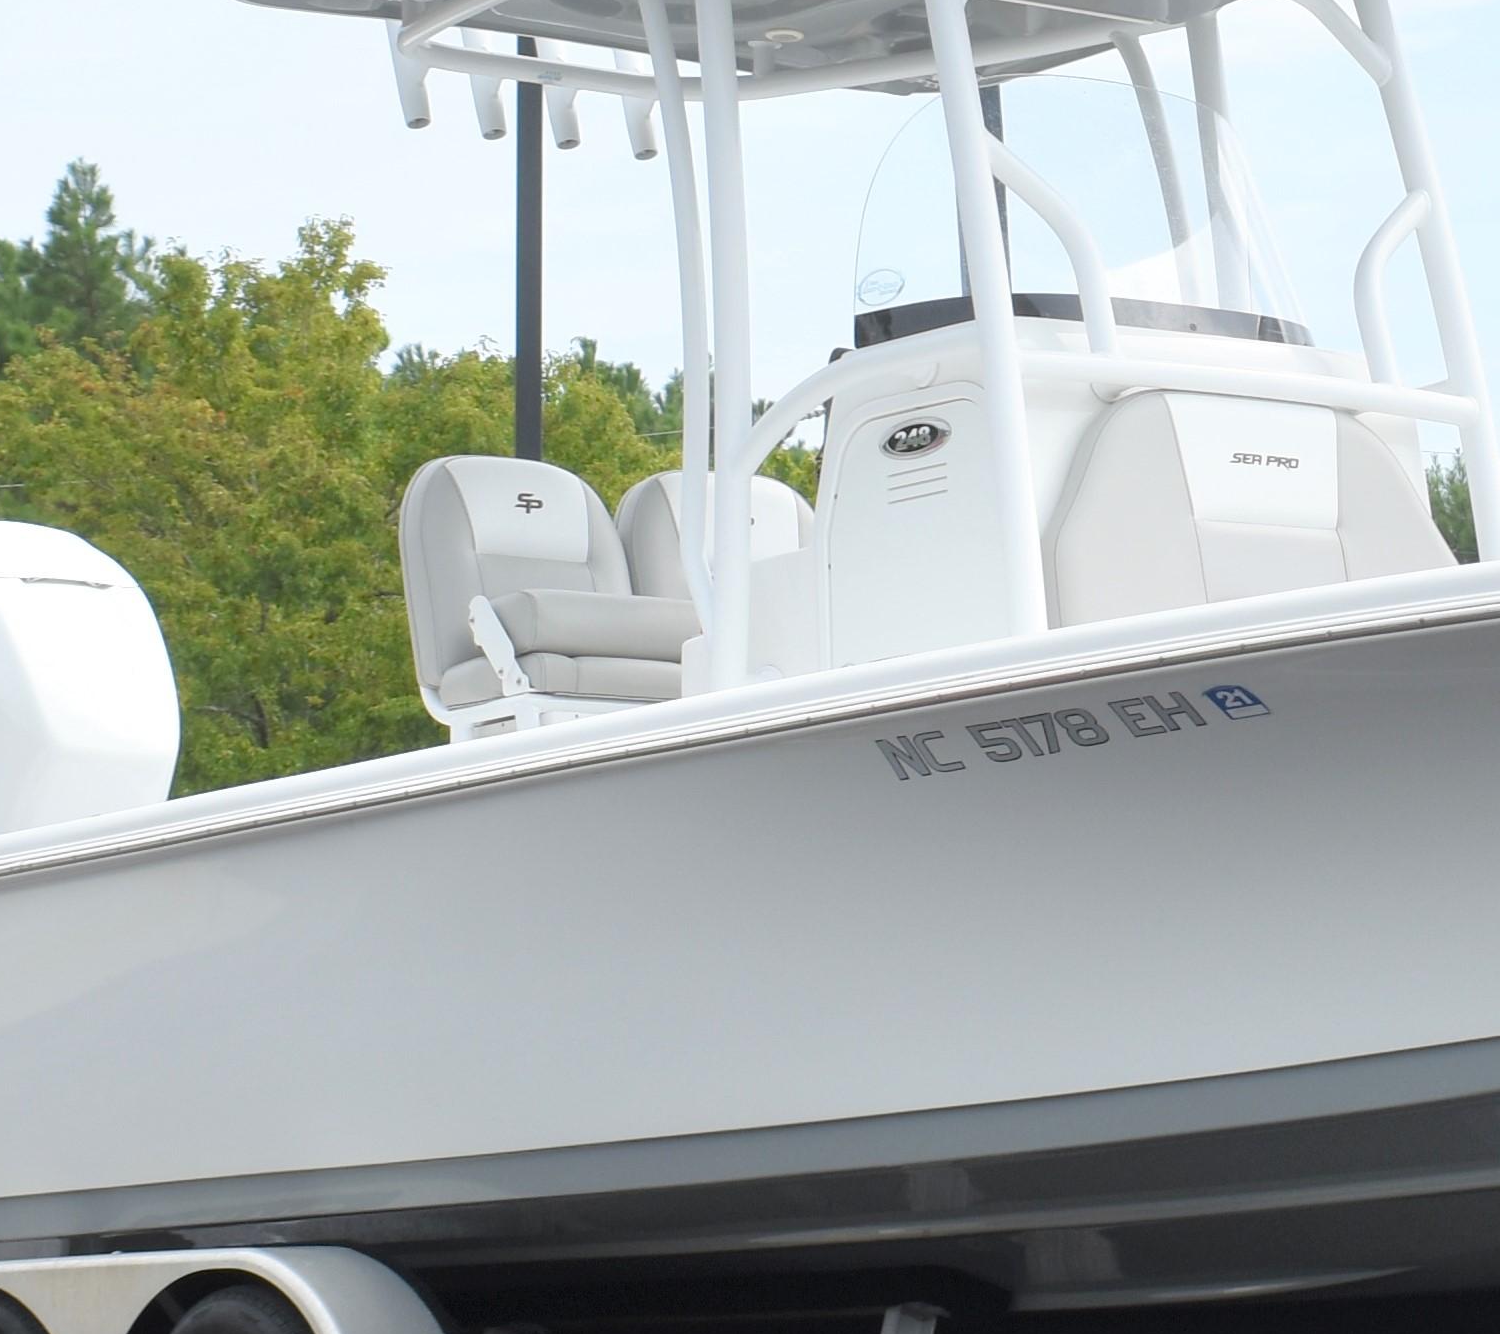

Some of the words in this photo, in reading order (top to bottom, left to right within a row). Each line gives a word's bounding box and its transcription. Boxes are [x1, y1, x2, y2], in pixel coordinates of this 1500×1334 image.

[894, 425, 932, 451] 248
[1229, 453, 1262, 466] SEA
[1266, 455, 1299, 471] PRO
[1216, 689, 1255, 709] 21
[875, 729, 966, 781] NC
[965, 707, 1110, 763] 5178
[1107, 691, 1208, 738] EH
